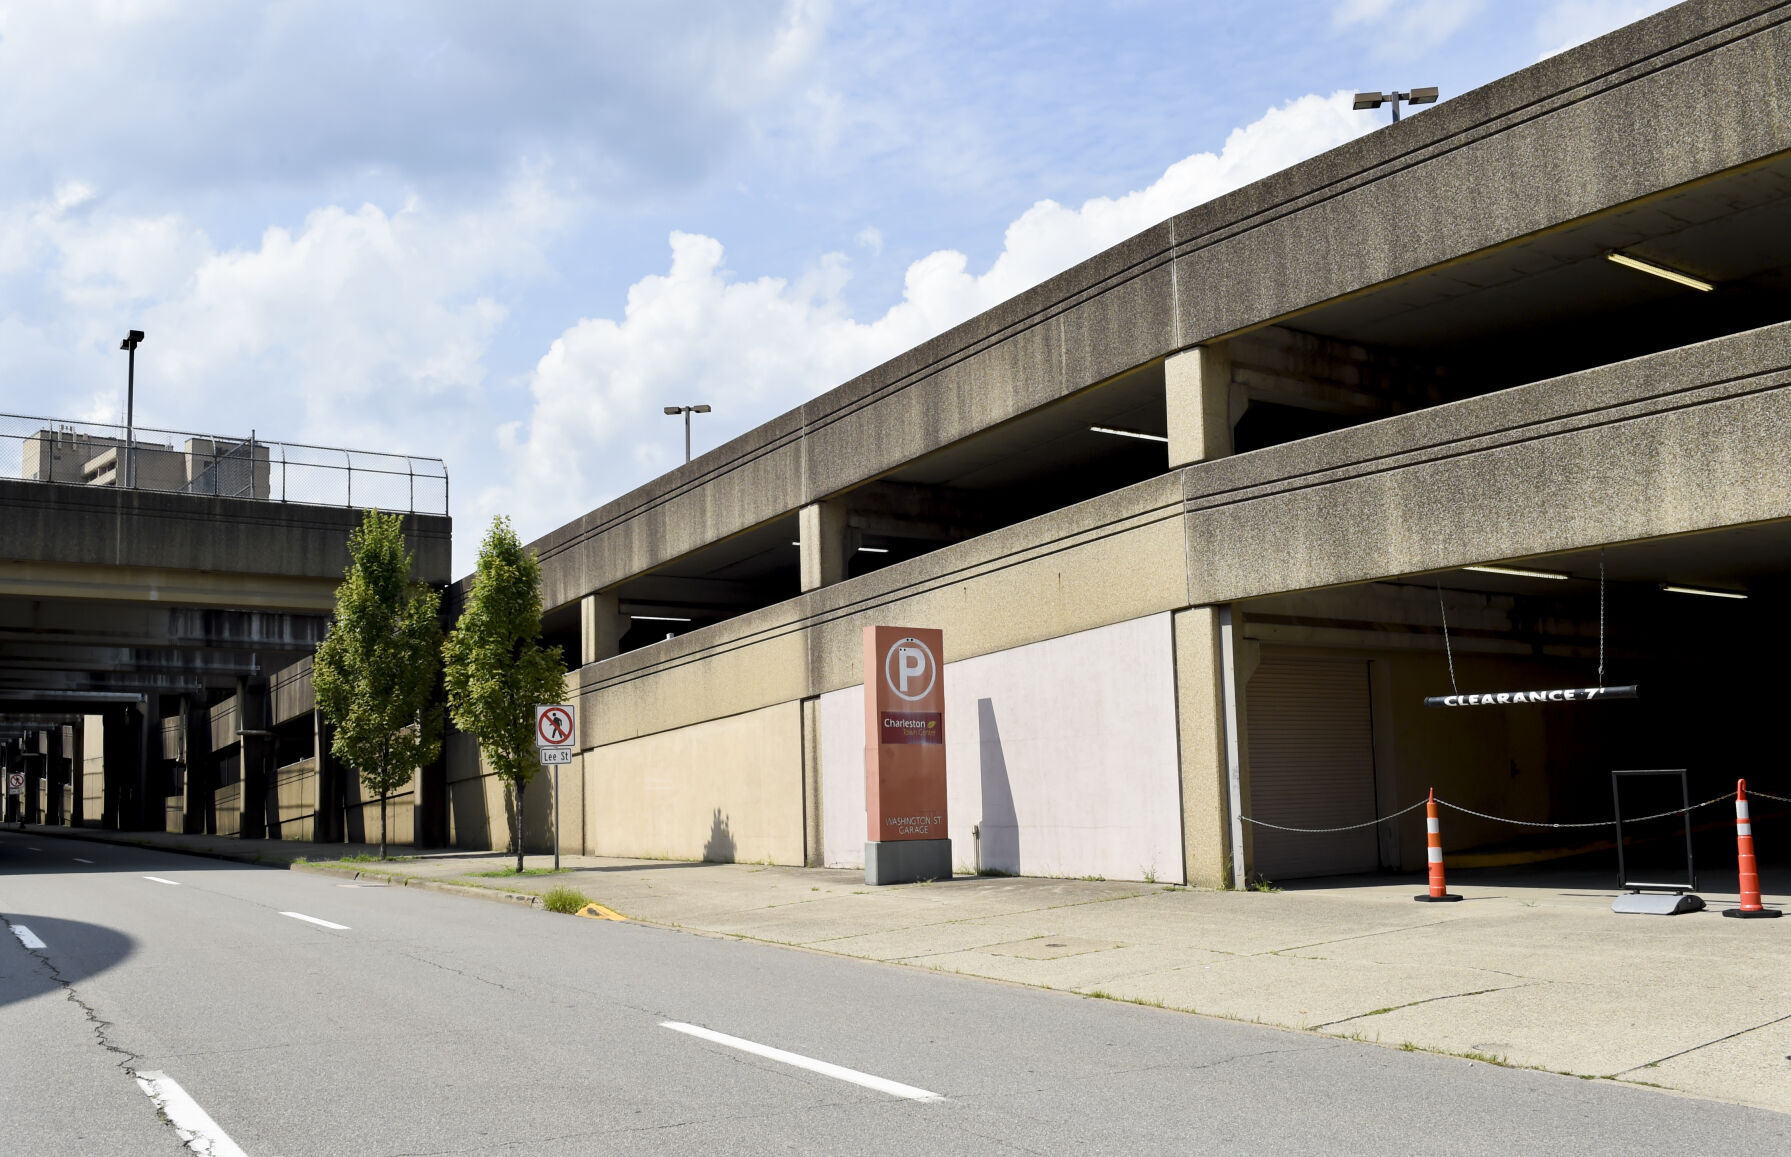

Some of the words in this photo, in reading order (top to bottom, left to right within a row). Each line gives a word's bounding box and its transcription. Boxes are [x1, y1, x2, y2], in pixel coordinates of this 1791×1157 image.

[899, 647, 926, 692] P
[1444, 689, 1575, 706] CLEARANCE
[884, 718, 926, 728] Charleston
[544, 752, 557, 761] Lee
[560, 752, 568, 760] St
[886, 816, 931, 826] WASHINGTON
[933, 816, 942, 825] ST
[898, 825, 929, 834] GARAGE
